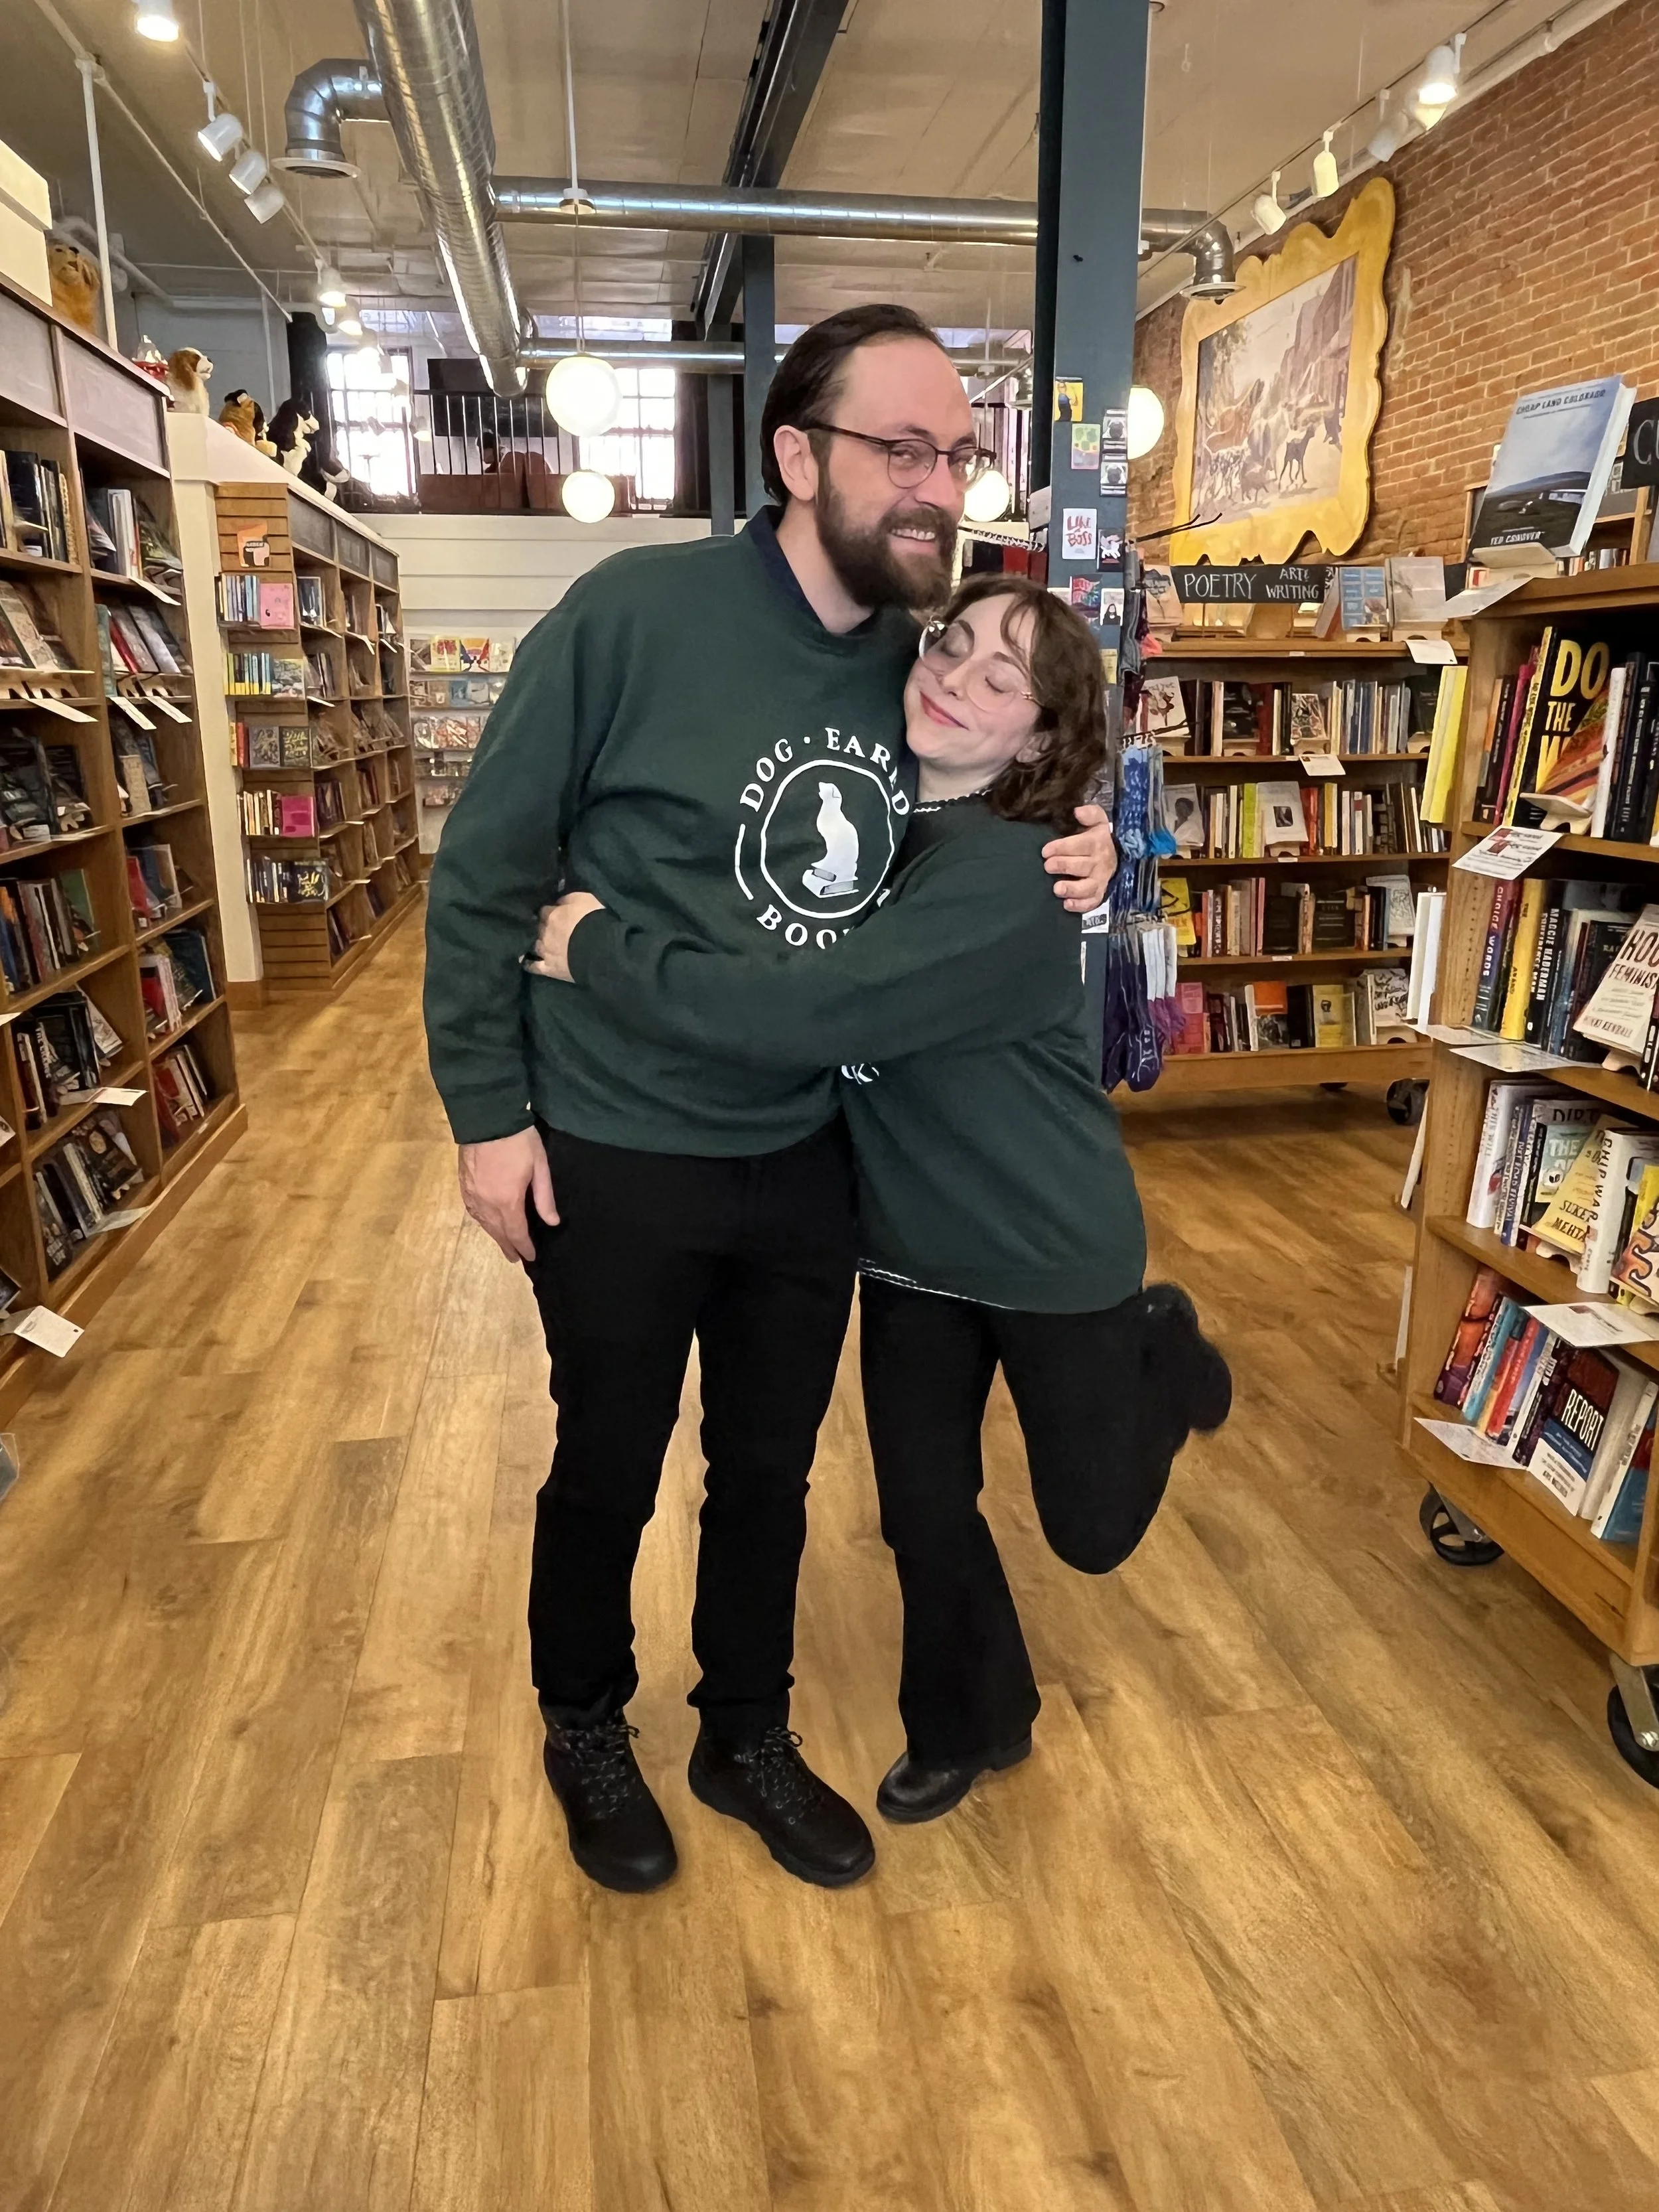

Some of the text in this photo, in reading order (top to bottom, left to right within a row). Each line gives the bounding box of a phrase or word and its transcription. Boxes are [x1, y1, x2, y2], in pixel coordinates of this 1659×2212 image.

[1184, 573, 1258, 600] POETRY
[1265, 583, 1320, 599] WRITING
[1550, 639, 1610, 700] DO
[1545, 701, 1576, 731] THE
[740, 738, 794, 812] DOG
[1548, 1139, 1581, 1157] THE
[1561, 1388, 1605, 1451] REPORT
